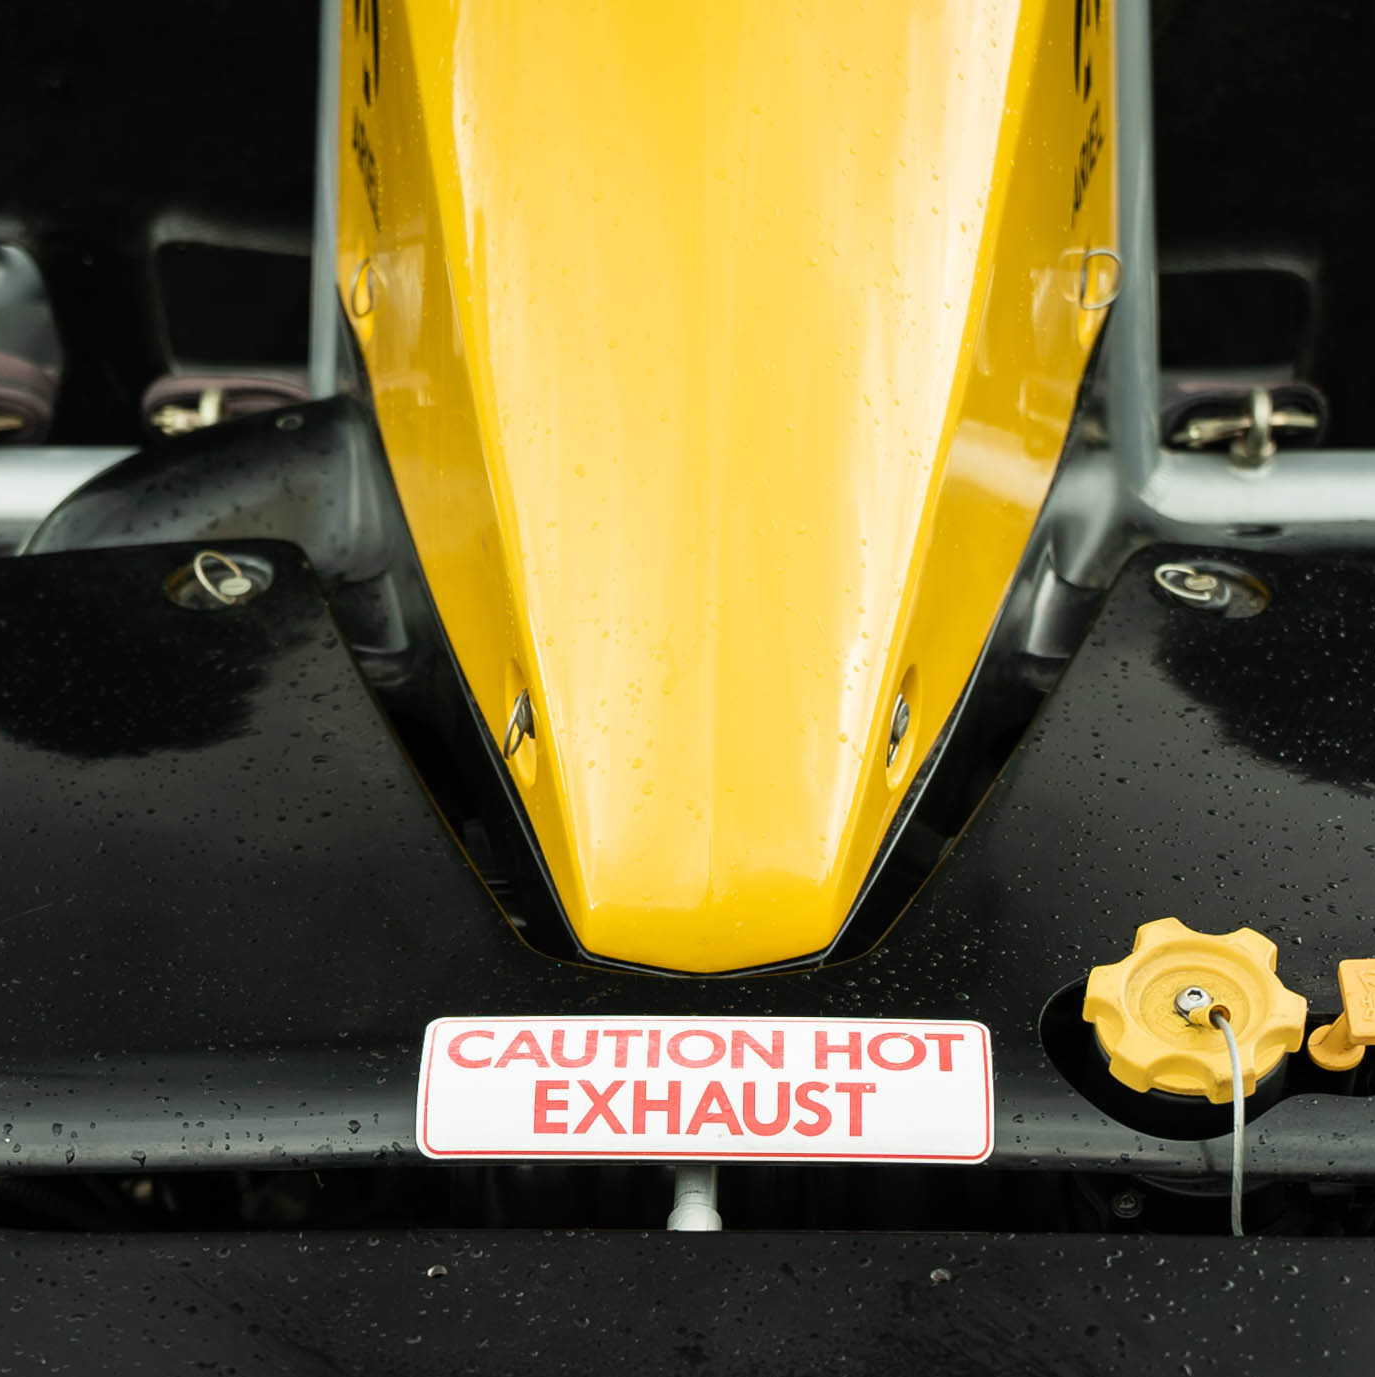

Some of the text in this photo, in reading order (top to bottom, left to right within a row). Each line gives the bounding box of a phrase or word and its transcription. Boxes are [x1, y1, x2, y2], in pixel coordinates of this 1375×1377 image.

[447, 1028, 965, 1073] CAUTION HOT
[532, 1079, 877, 1137] EXHAUST
